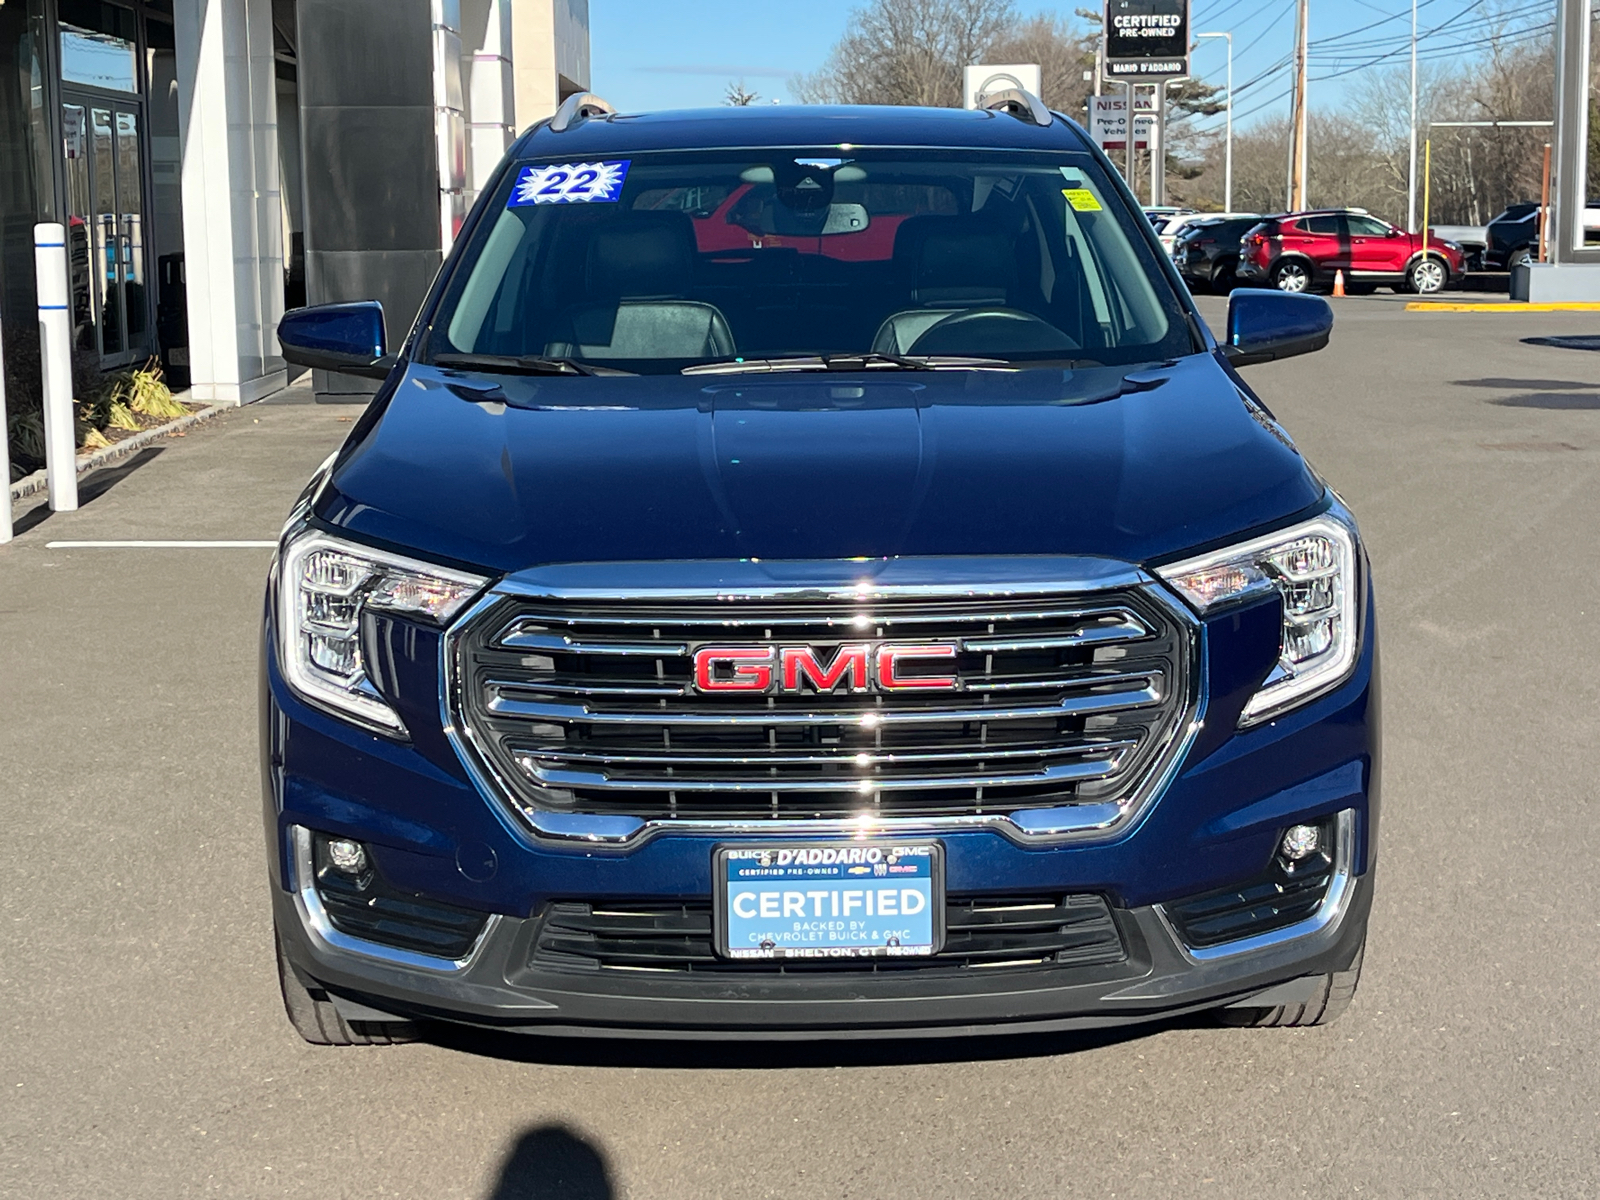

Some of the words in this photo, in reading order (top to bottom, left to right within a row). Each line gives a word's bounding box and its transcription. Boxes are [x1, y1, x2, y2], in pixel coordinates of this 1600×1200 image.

[1114, 15, 1180, 27] CERTIFIED
[1120, 28, 1175, 37] PRE-OWNED
[1113, 63, 1138, 73] MARIO
[1140, 62, 1181, 72] D'ADDARIO
[1097, 117, 1154, 125] Pre-Oned
[1104, 127, 1147, 135] Vehies
[537, 170, 597, 195] 22
[693, 644, 958, 694] GMC
[728, 850, 771, 860] BUICK
[777, 847, 882, 866] D'ADDARIO
[892, 847, 930, 856] GMC
[787, 867, 839, 875] PRE-OWNED
[733, 888, 926, 919] CERTIFIED
[793, 921, 845, 931] BACKED
[849, 921, 866, 930] BY
[748, 932, 824, 942] CHEVROLET
[829, 931, 867, 940] BUICK
[871, 930, 879, 940] &
[883, 929, 911, 939] GMC
